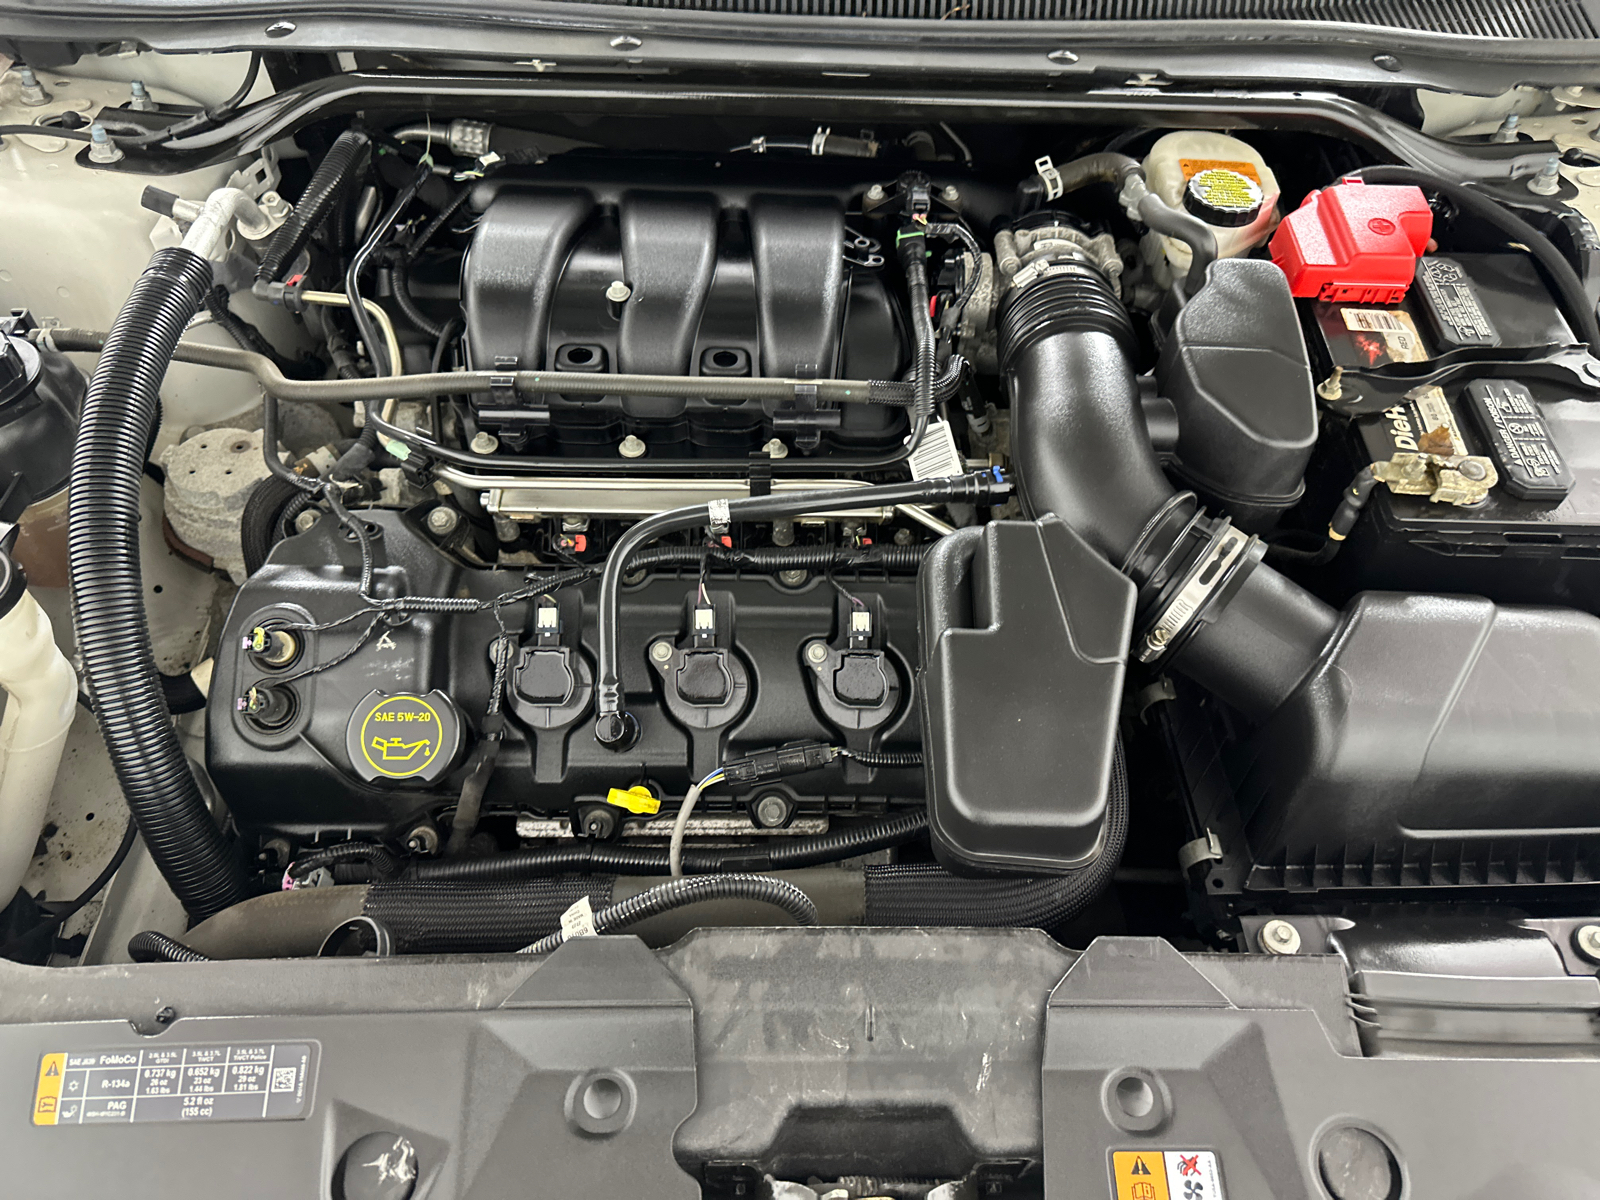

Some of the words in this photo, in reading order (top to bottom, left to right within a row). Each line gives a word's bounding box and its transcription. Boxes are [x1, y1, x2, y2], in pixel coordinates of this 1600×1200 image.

[1397, 335, 1410, 350] RED
[1483, 397, 1502, 423] POISON
[1499, 429, 1520, 459] DANGER
[374, 712, 395, 722] SAE
[397, 712, 431, 722] 5W-20
[99, 1054, 137, 1065] FoMoCo
[144, 1068, 165, 1078] 0.737
[166, 1069, 177, 1079] kg
[187, 1067, 209, 1077] 0.652
[210, 1067, 220, 1078] kg
[232, 1065, 254, 1075] 0.822
[254, 1065, 265, 1076] kg
[101, 1079, 131, 1088] R-134a
[193, 1077, 202, 1085] 23
[160, 1086, 171, 1094] lbs
[189, 1085, 203, 1093] 1.44
[248, 1083, 259, 1091] lbs
[107, 1101, 127, 1110] PAG
[183, 1096, 196, 1106] 5.2
[196, 1096, 203, 1106] fl
[203, 1097, 215, 1105] oz
[181, 1106, 199, 1118] (155
[199, 1106, 213, 1118] cc)
